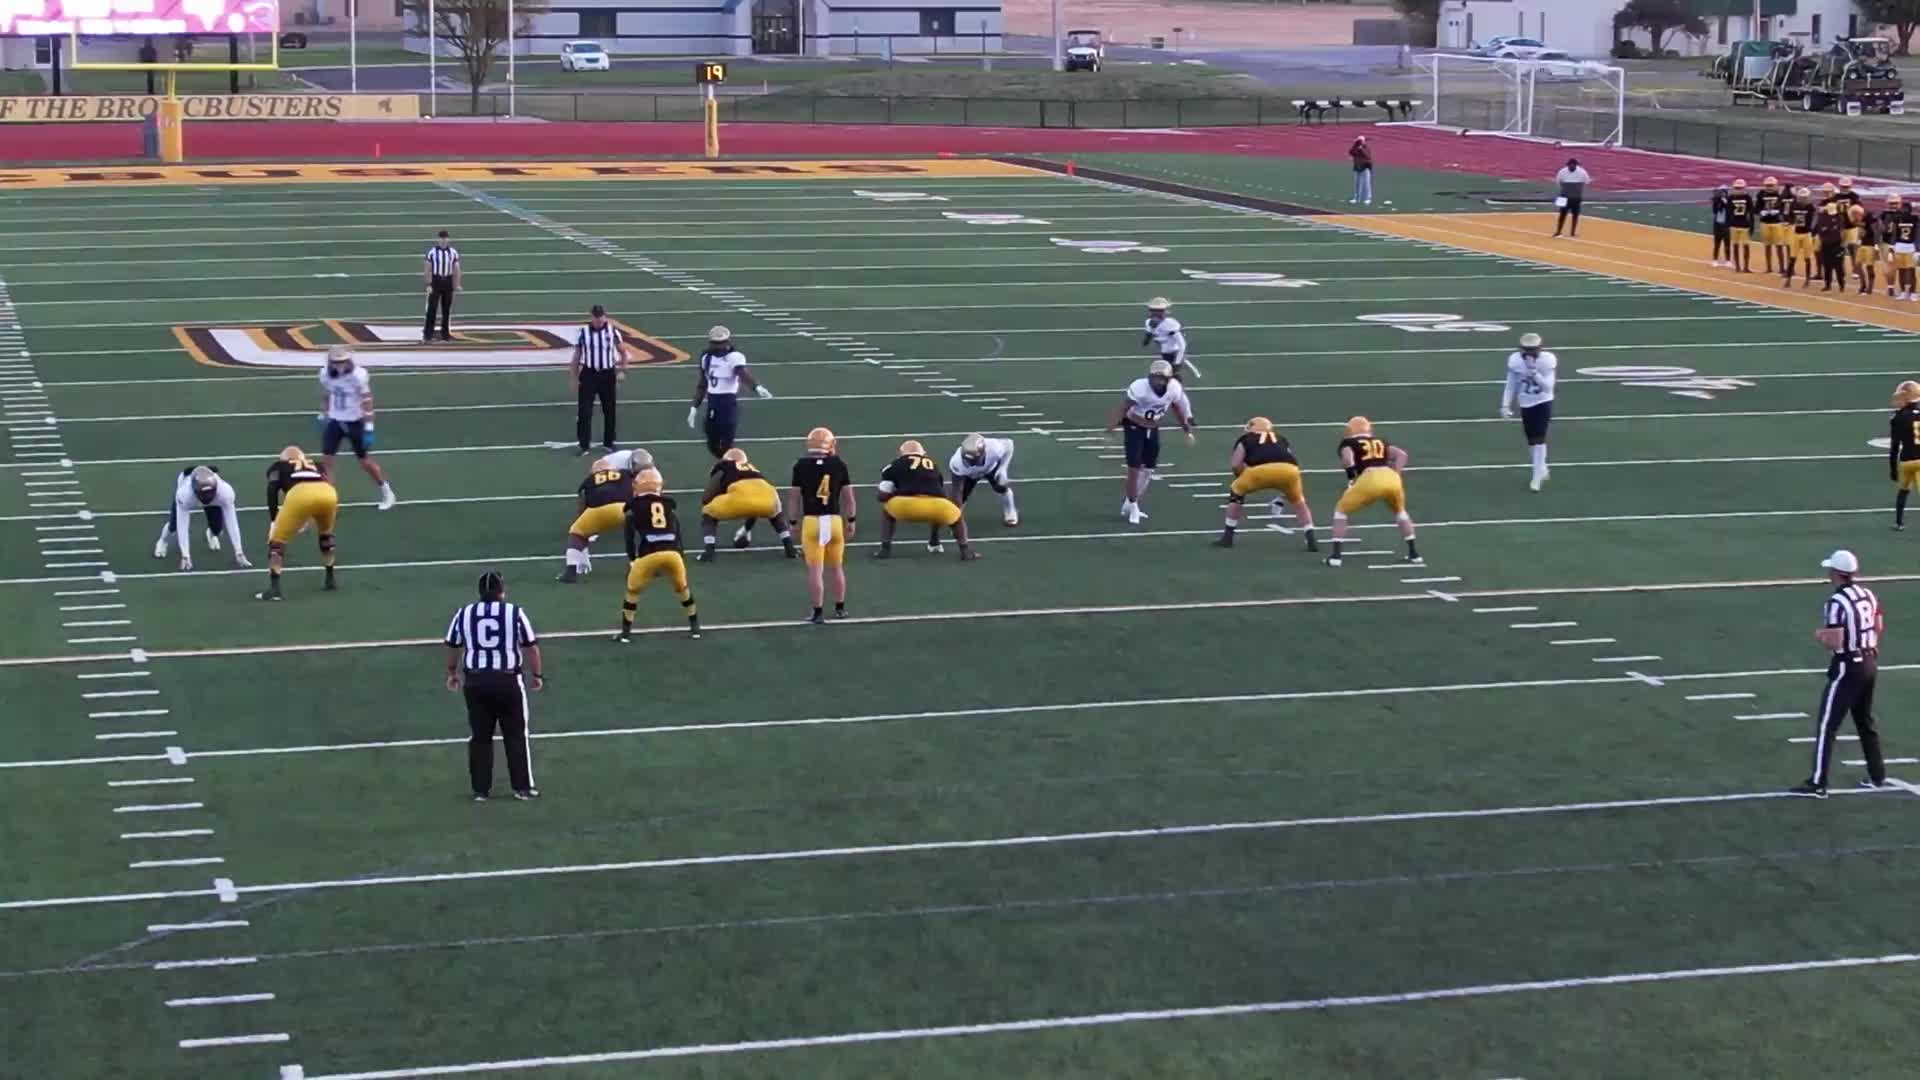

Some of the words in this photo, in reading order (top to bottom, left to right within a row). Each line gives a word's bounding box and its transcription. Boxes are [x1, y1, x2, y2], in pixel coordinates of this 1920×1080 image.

[706, 65, 723, 81] 19
[27, 98, 87, 119] THE
[96, 95, 343, 119] BROCBUSTERS
[1357, 439, 1385, 461] 30
[908, 455, 934, 470] 70
[816, 474, 831, 506] 4
[650, 501, 667, 529] 8
[477, 618, 500, 648] C
